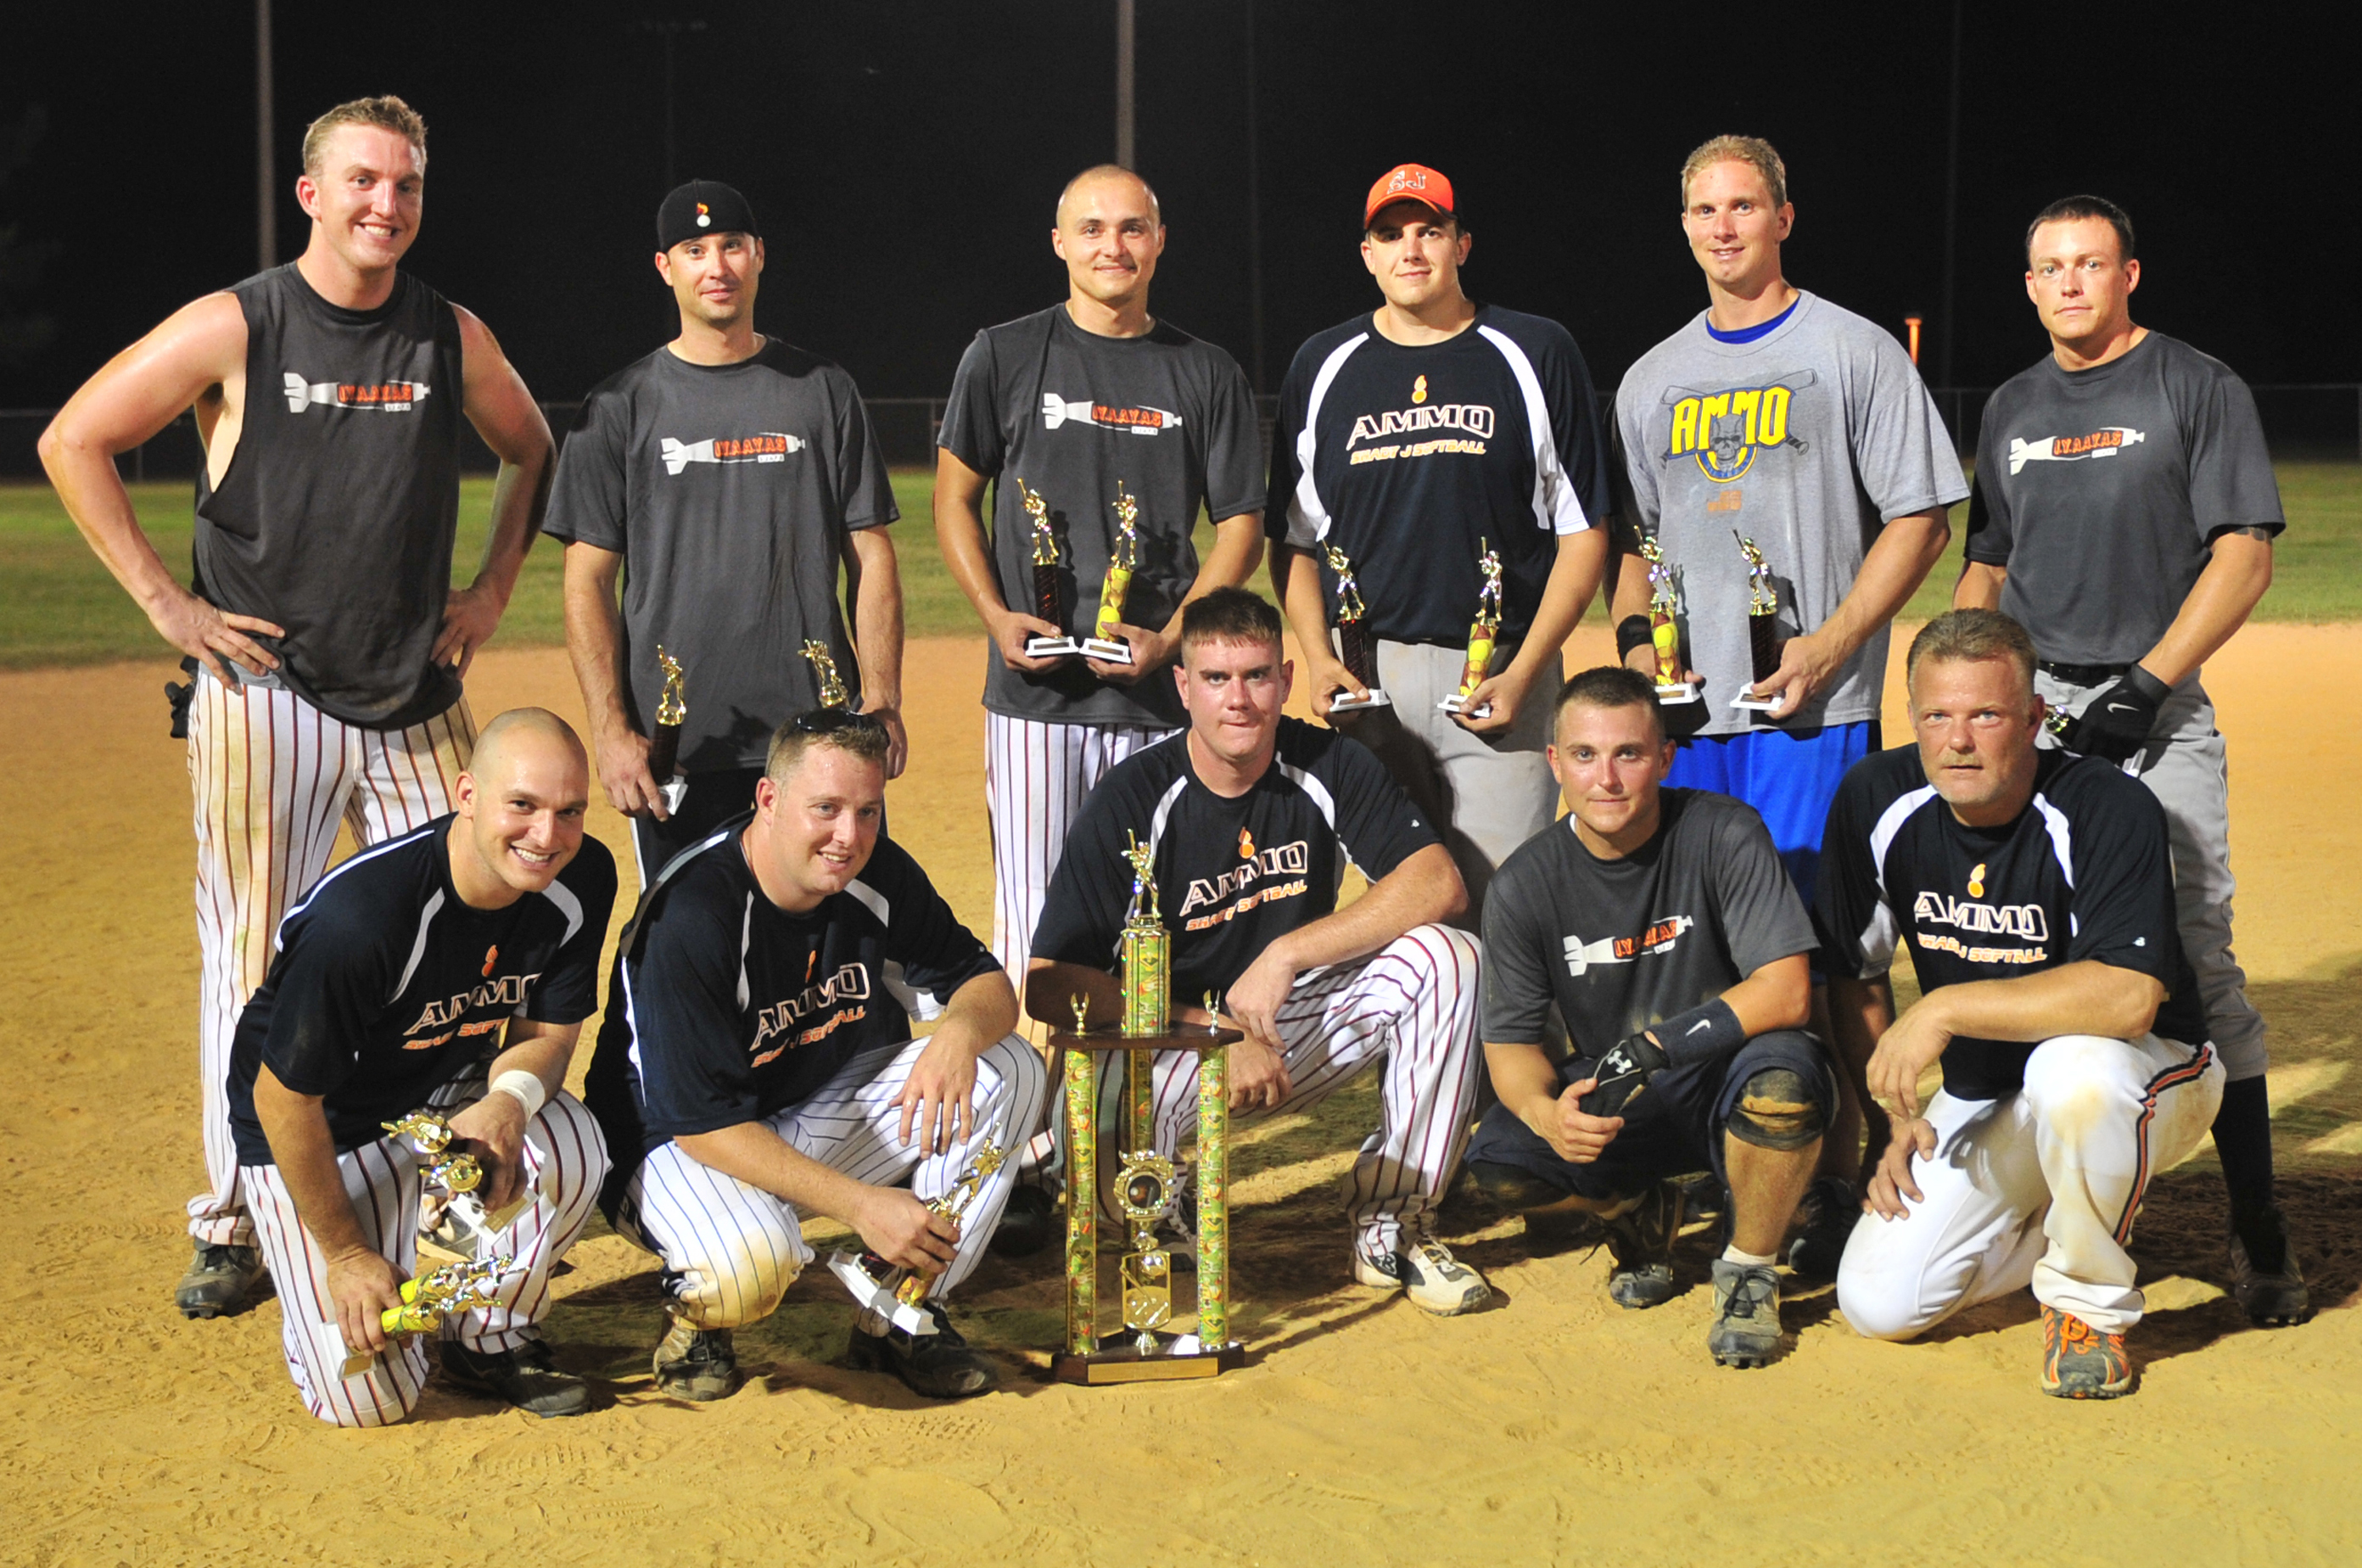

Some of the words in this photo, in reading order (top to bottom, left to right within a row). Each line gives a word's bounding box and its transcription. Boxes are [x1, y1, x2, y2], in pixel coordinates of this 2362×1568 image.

[1346, 405, 1494, 451] AMMO
[1671, 387, 1791, 455] AMMO
[1350, 445, 1401, 465] SHADY
[1400, 445, 1413, 457] J
[1412, 440, 1486, 456] SOFTBALL
[1179, 840, 1307, 916] AMMO
[1967, 947, 2047, 964] SOFTALL
